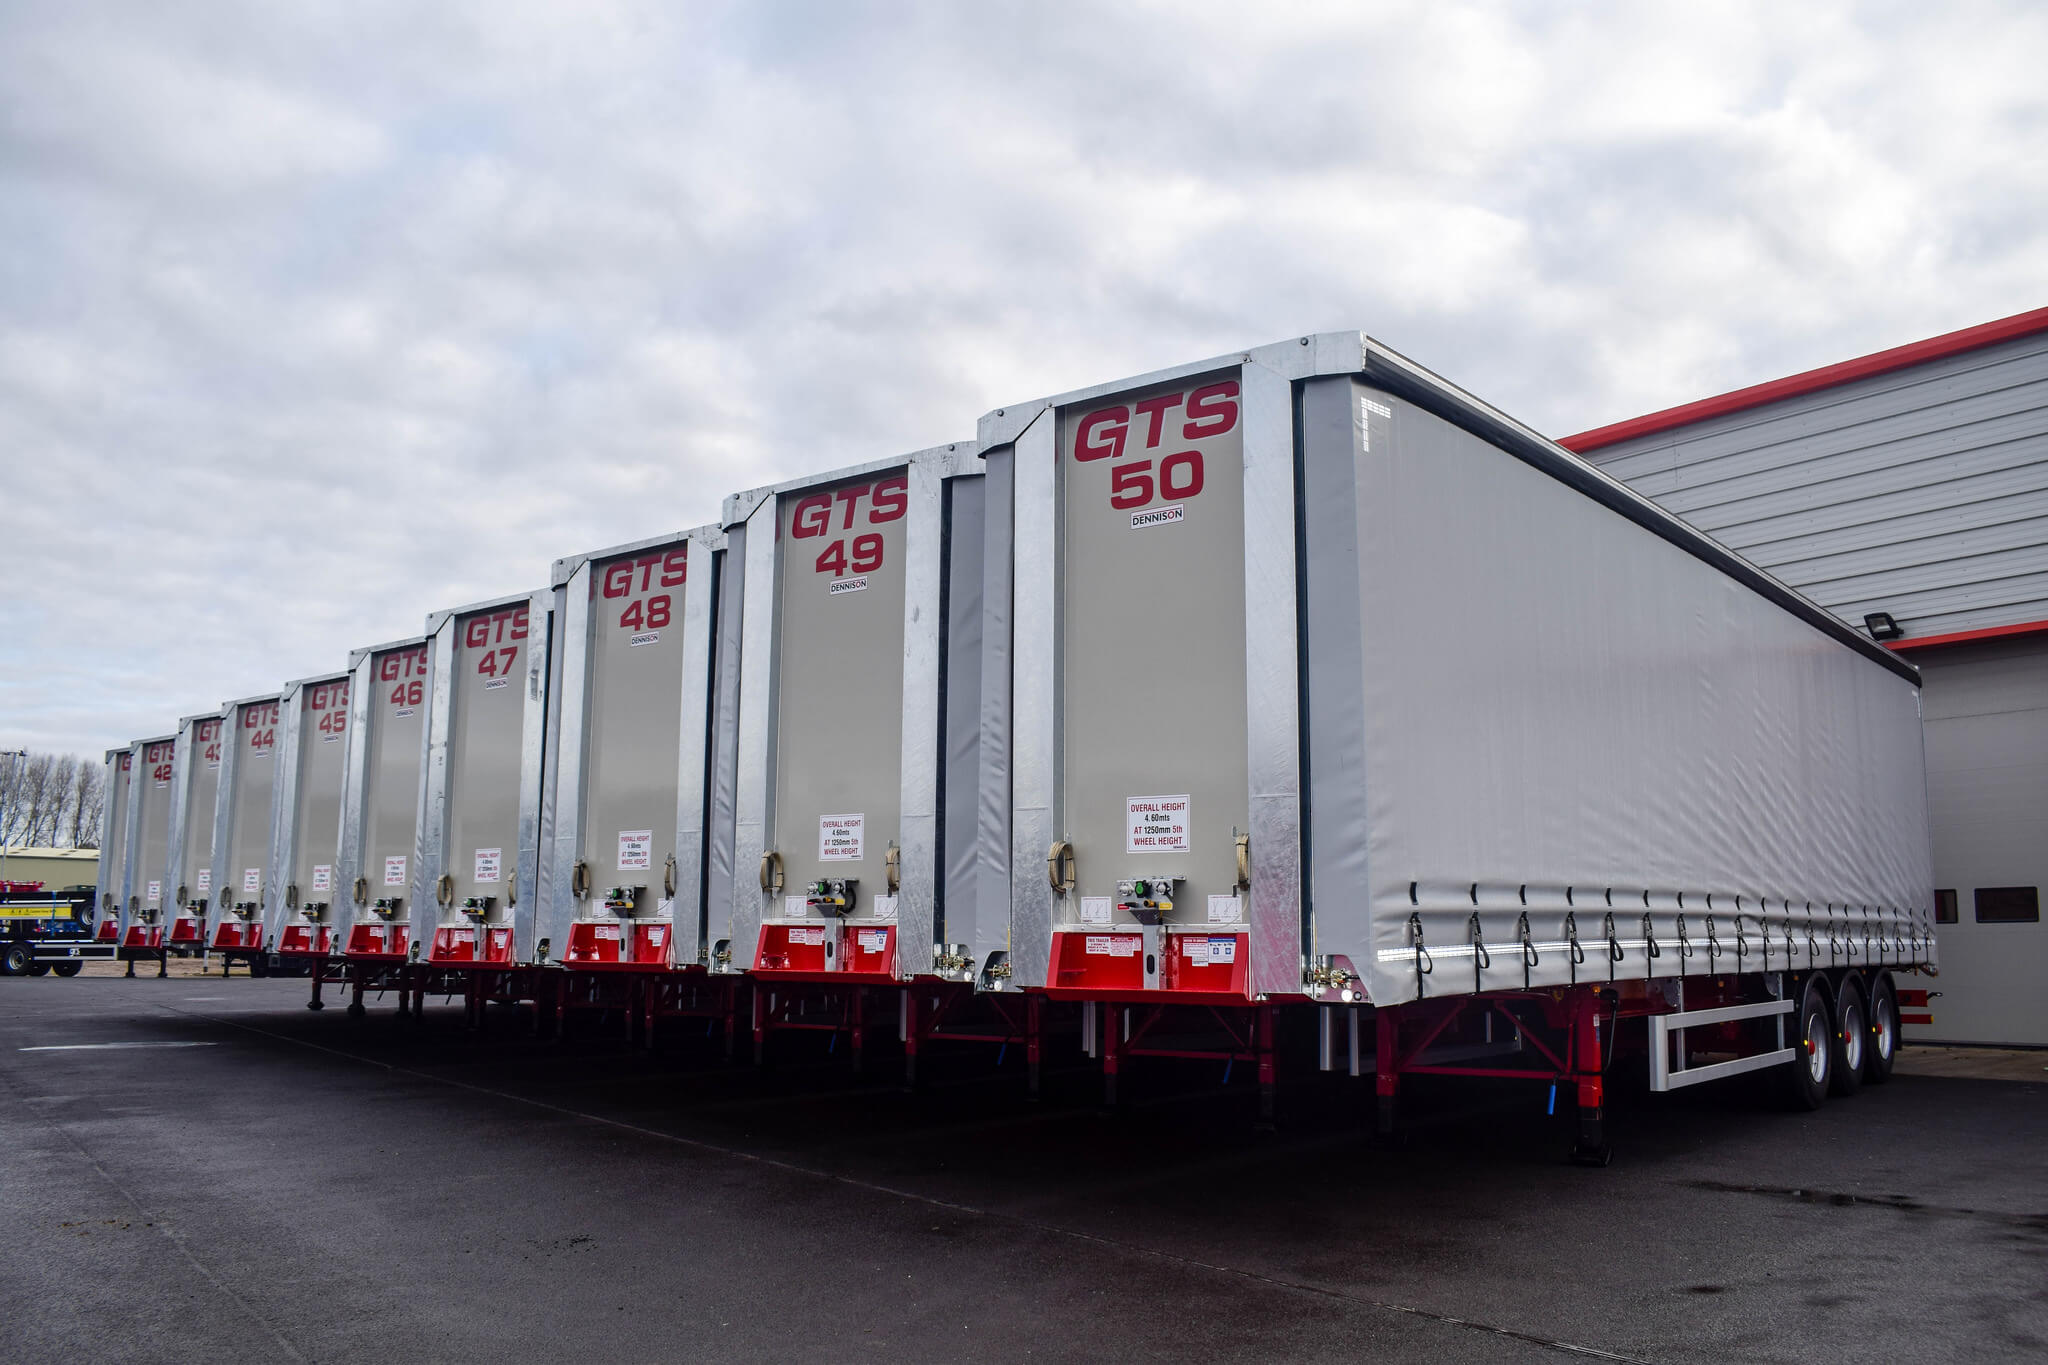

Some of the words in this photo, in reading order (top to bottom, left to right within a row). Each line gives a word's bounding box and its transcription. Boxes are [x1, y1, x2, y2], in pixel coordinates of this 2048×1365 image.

[1074, 380, 1240, 462] GTS
[1111, 450, 1204, 510] 50
[792, 476, 908, 539] GTS
[1132, 509, 1183, 526] DENNISON
[815, 533, 884, 577] 49
[603, 550, 688, 599] GTS
[830, 579, 867, 592] DENNISON
[619, 594, 671, 631] 48
[466, 606, 529, 648] GTS
[478, 646, 518, 677] 47
[390, 681, 423, 706] 46
[319, 710, 346, 733] 45
[251, 728, 275, 749] 44
[154, 764, 172, 781] 42
[1130, 803, 1160, 812] OVERALL
[1161, 802, 1186, 811] HEIGHT
[1133, 826, 1142, 834] AT
[1144, 825, 1171, 834] 1250mm
[1172, 825, 1183, 833] 5th
[1133, 837, 1156, 846] WHEEL
[1158, 836, 1182, 845] HEIGHT
